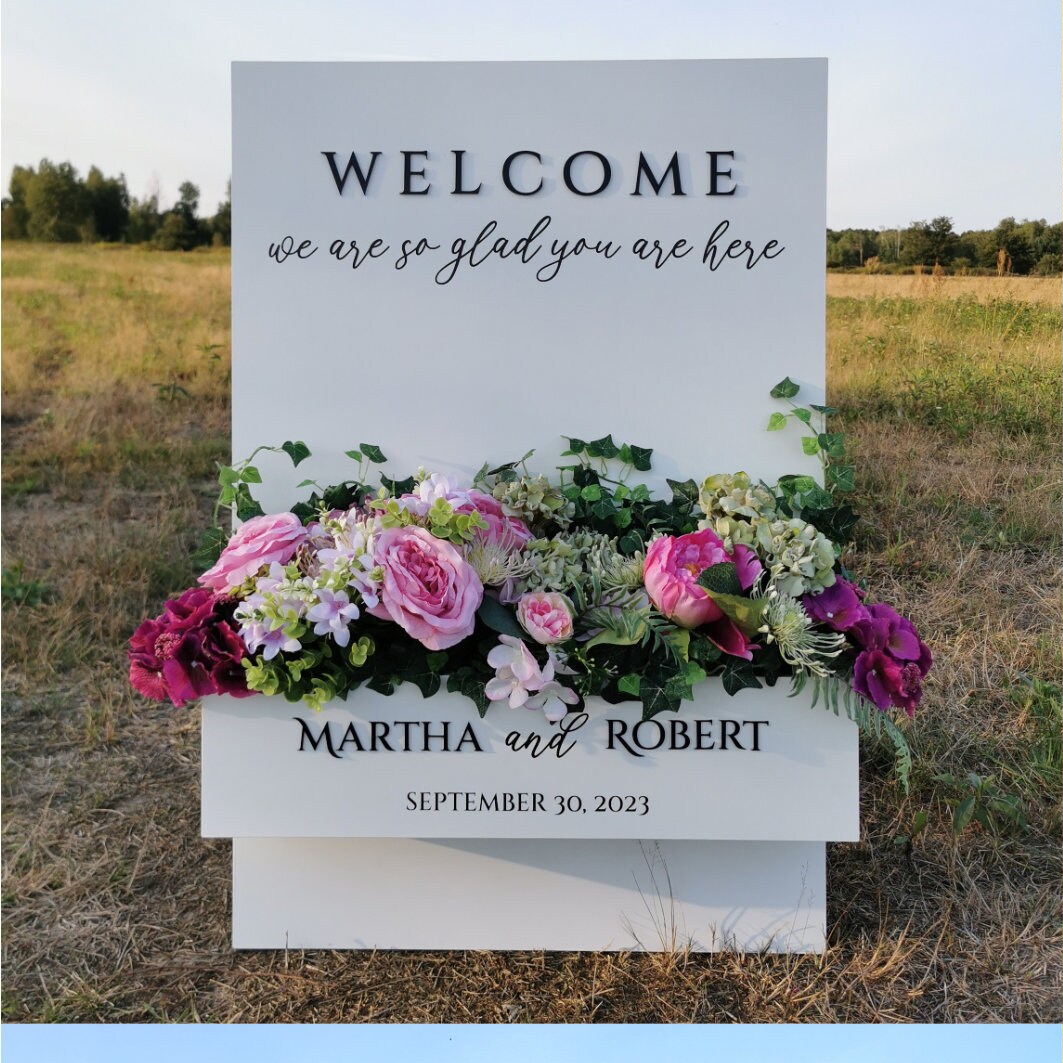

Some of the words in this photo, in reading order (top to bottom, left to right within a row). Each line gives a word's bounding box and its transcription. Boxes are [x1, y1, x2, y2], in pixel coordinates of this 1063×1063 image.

[320, 150, 737, 197] WELCOME
[268, 235, 319, 264] we
[329, 238, 390, 270] are
[394, 237, 441, 271] so
[434, 215, 552, 286] glad
[536, 237, 622, 283] you
[632, 238, 694, 270] are
[702, 219, 785, 272] here
[293, 716, 484, 759] MARTHA
[504, 712, 590, 759] and
[605, 718, 770, 758] ROBERT
[406, 791, 547, 812] SEPTEMBER
[554, 795, 587, 816] 30,
[594, 795, 650, 816] 2023
